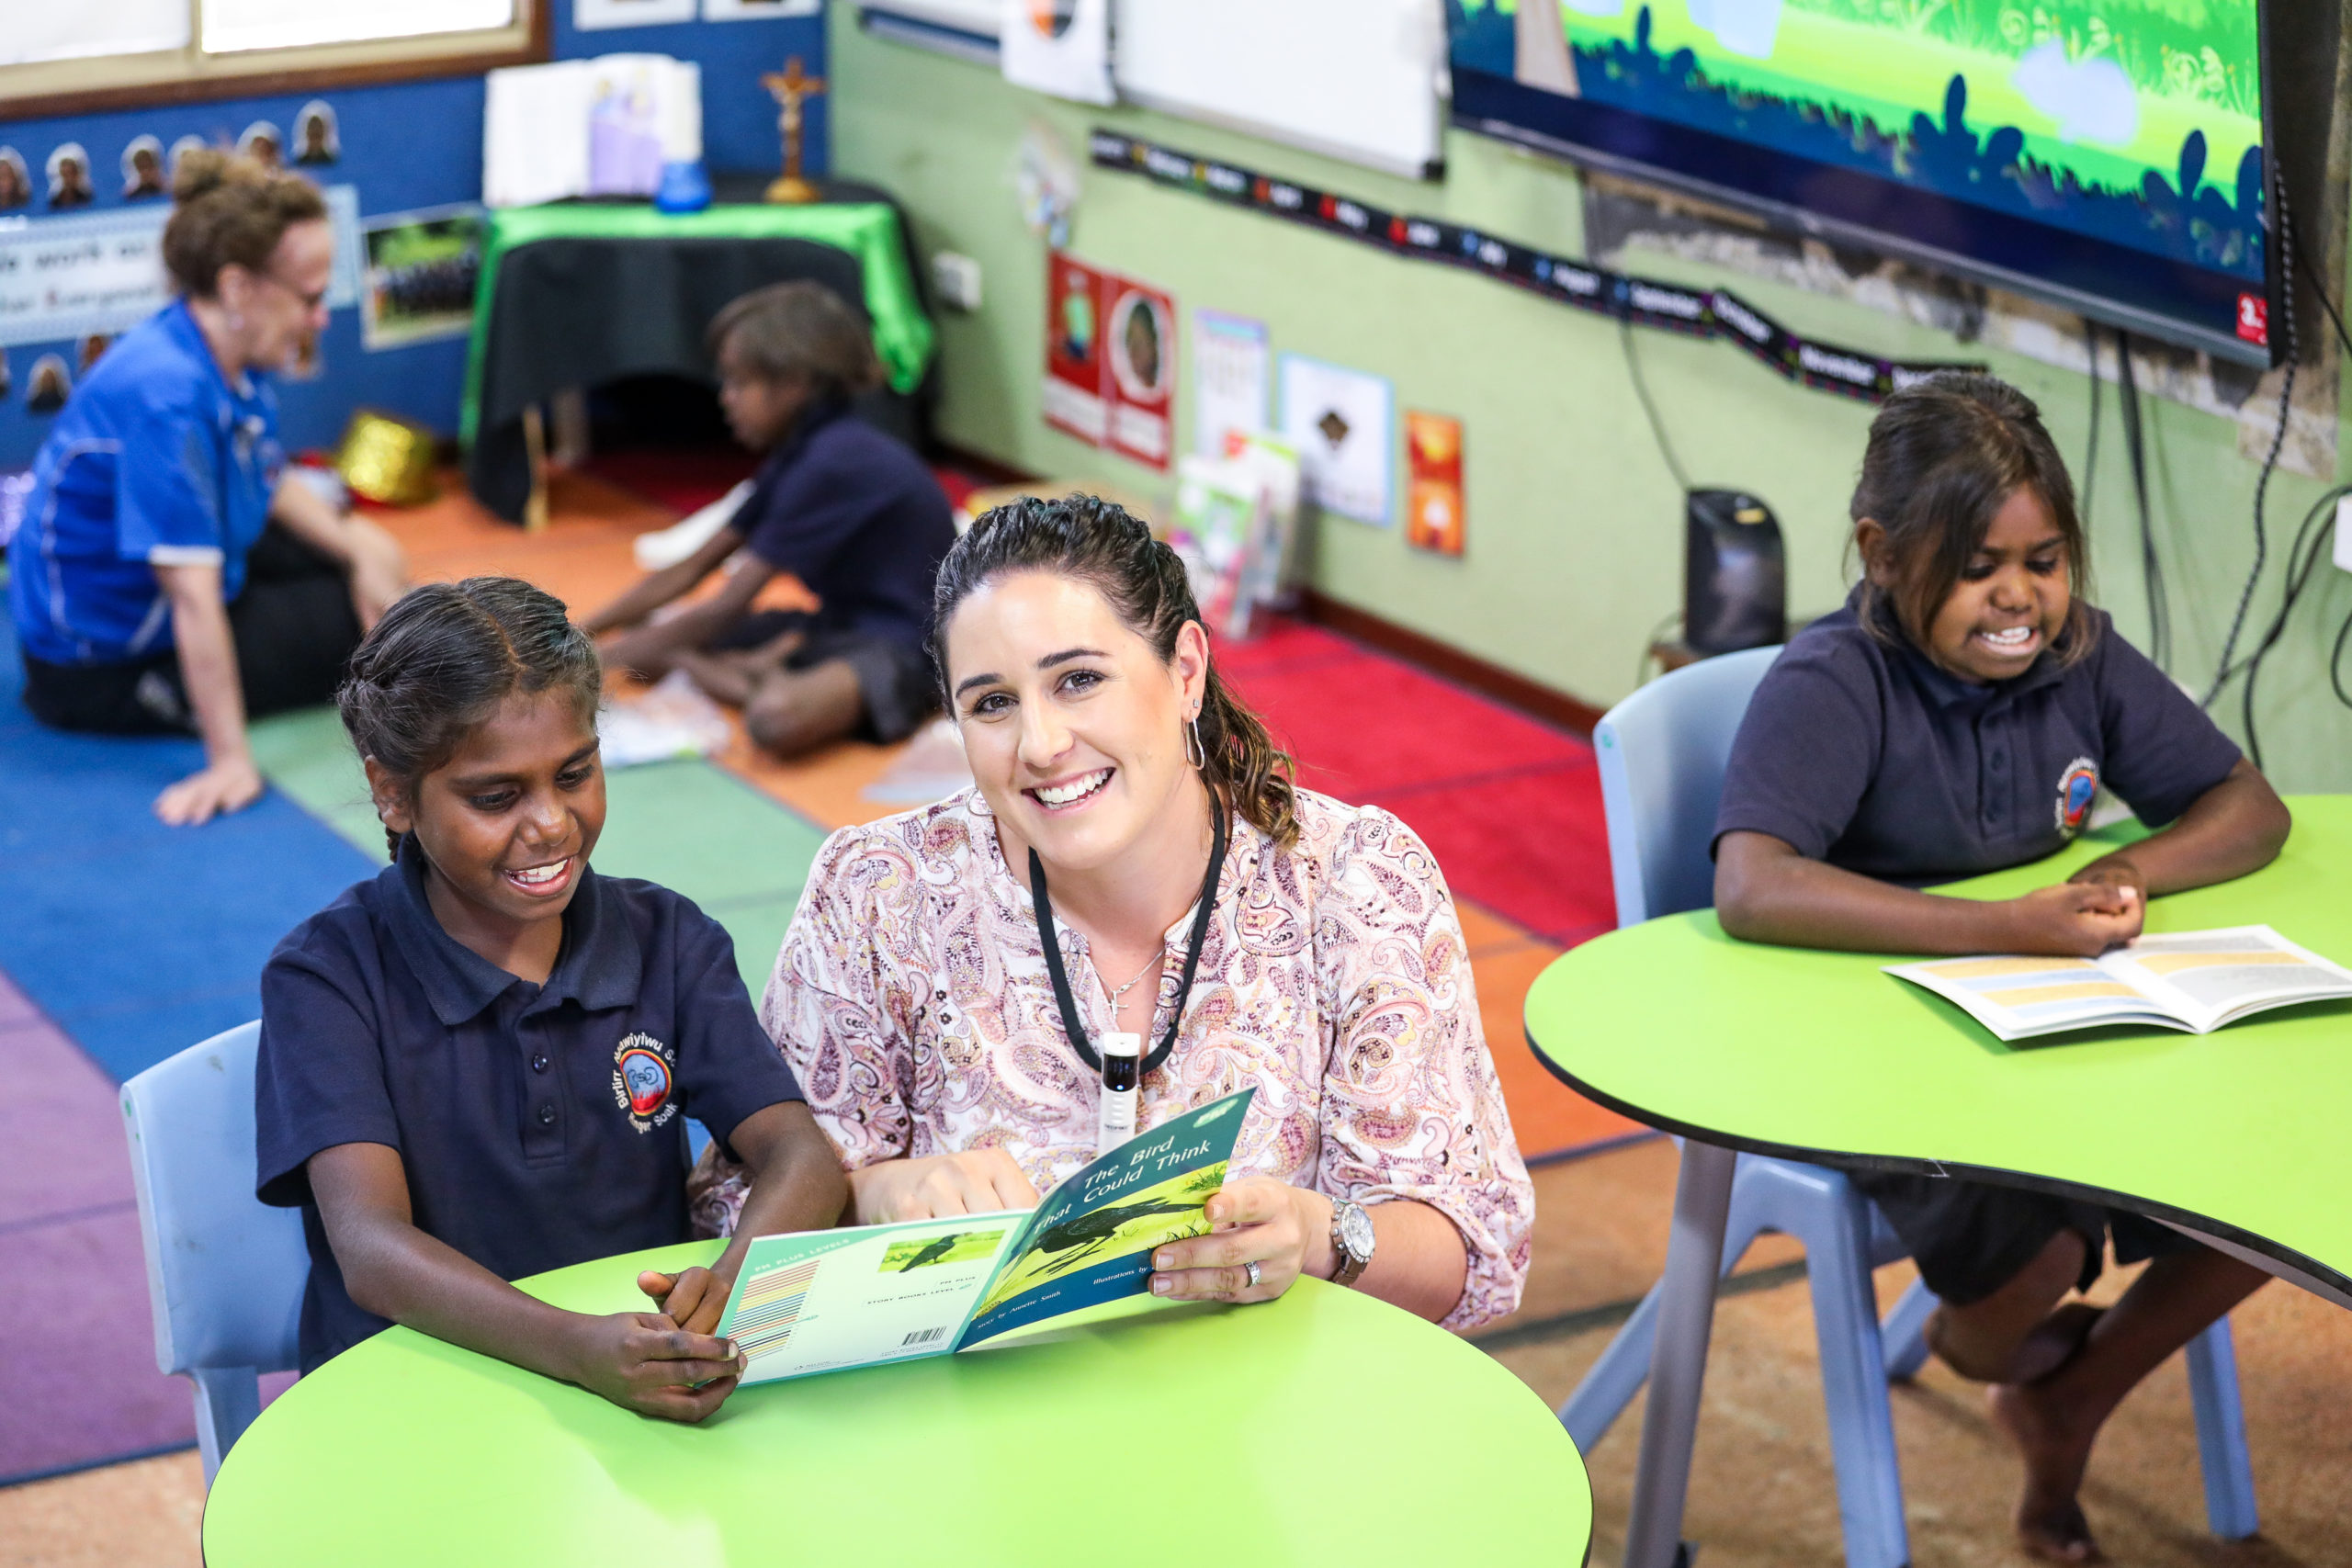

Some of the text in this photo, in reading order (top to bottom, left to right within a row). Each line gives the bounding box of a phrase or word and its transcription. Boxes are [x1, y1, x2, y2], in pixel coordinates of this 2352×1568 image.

[653, 1102, 678, 1127] Soak
[1084, 1135, 1175, 1190] The Bird
[1034, 1139, 1212, 1235] That Could Think
[754, 1238, 850, 1272] PM PLUS LEVELS
[1093, 1265, 1148, 1285] Illustrations by
[1009, 1299, 1036, 1314] Annette
[1041, 1291, 1061, 1302] Smith
